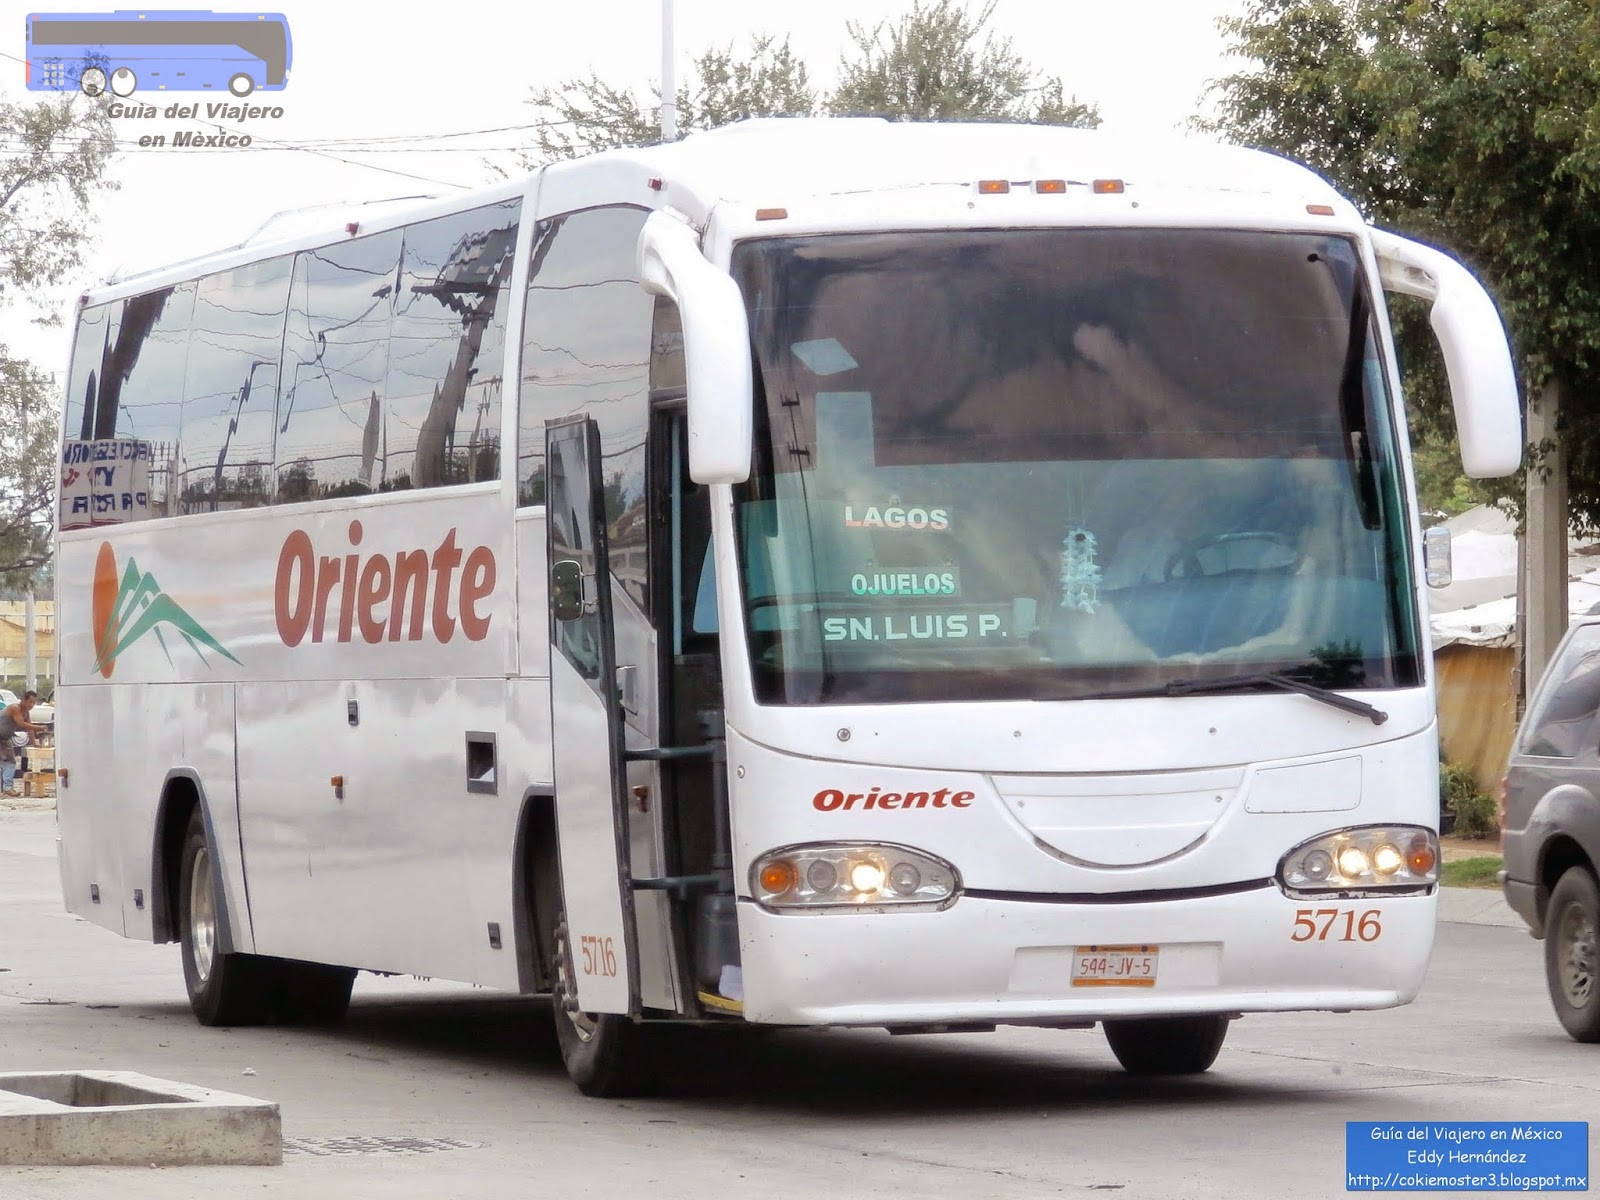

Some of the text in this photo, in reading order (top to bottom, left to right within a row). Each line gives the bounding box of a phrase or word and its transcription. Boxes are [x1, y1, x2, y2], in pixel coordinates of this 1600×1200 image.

[843, 505, 949, 530] LAGOS
[275, 520, 496, 648] Oriente
[851, 573, 955, 596] OJUELOS
[979, 614, 1007, 637] P.
[812, 787, 975, 812] Oriente
[1290, 909, 1382, 942] 5716
[581, 936, 616, 977] 5716
[1080, 957, 1151, 976] 544-JV-5
